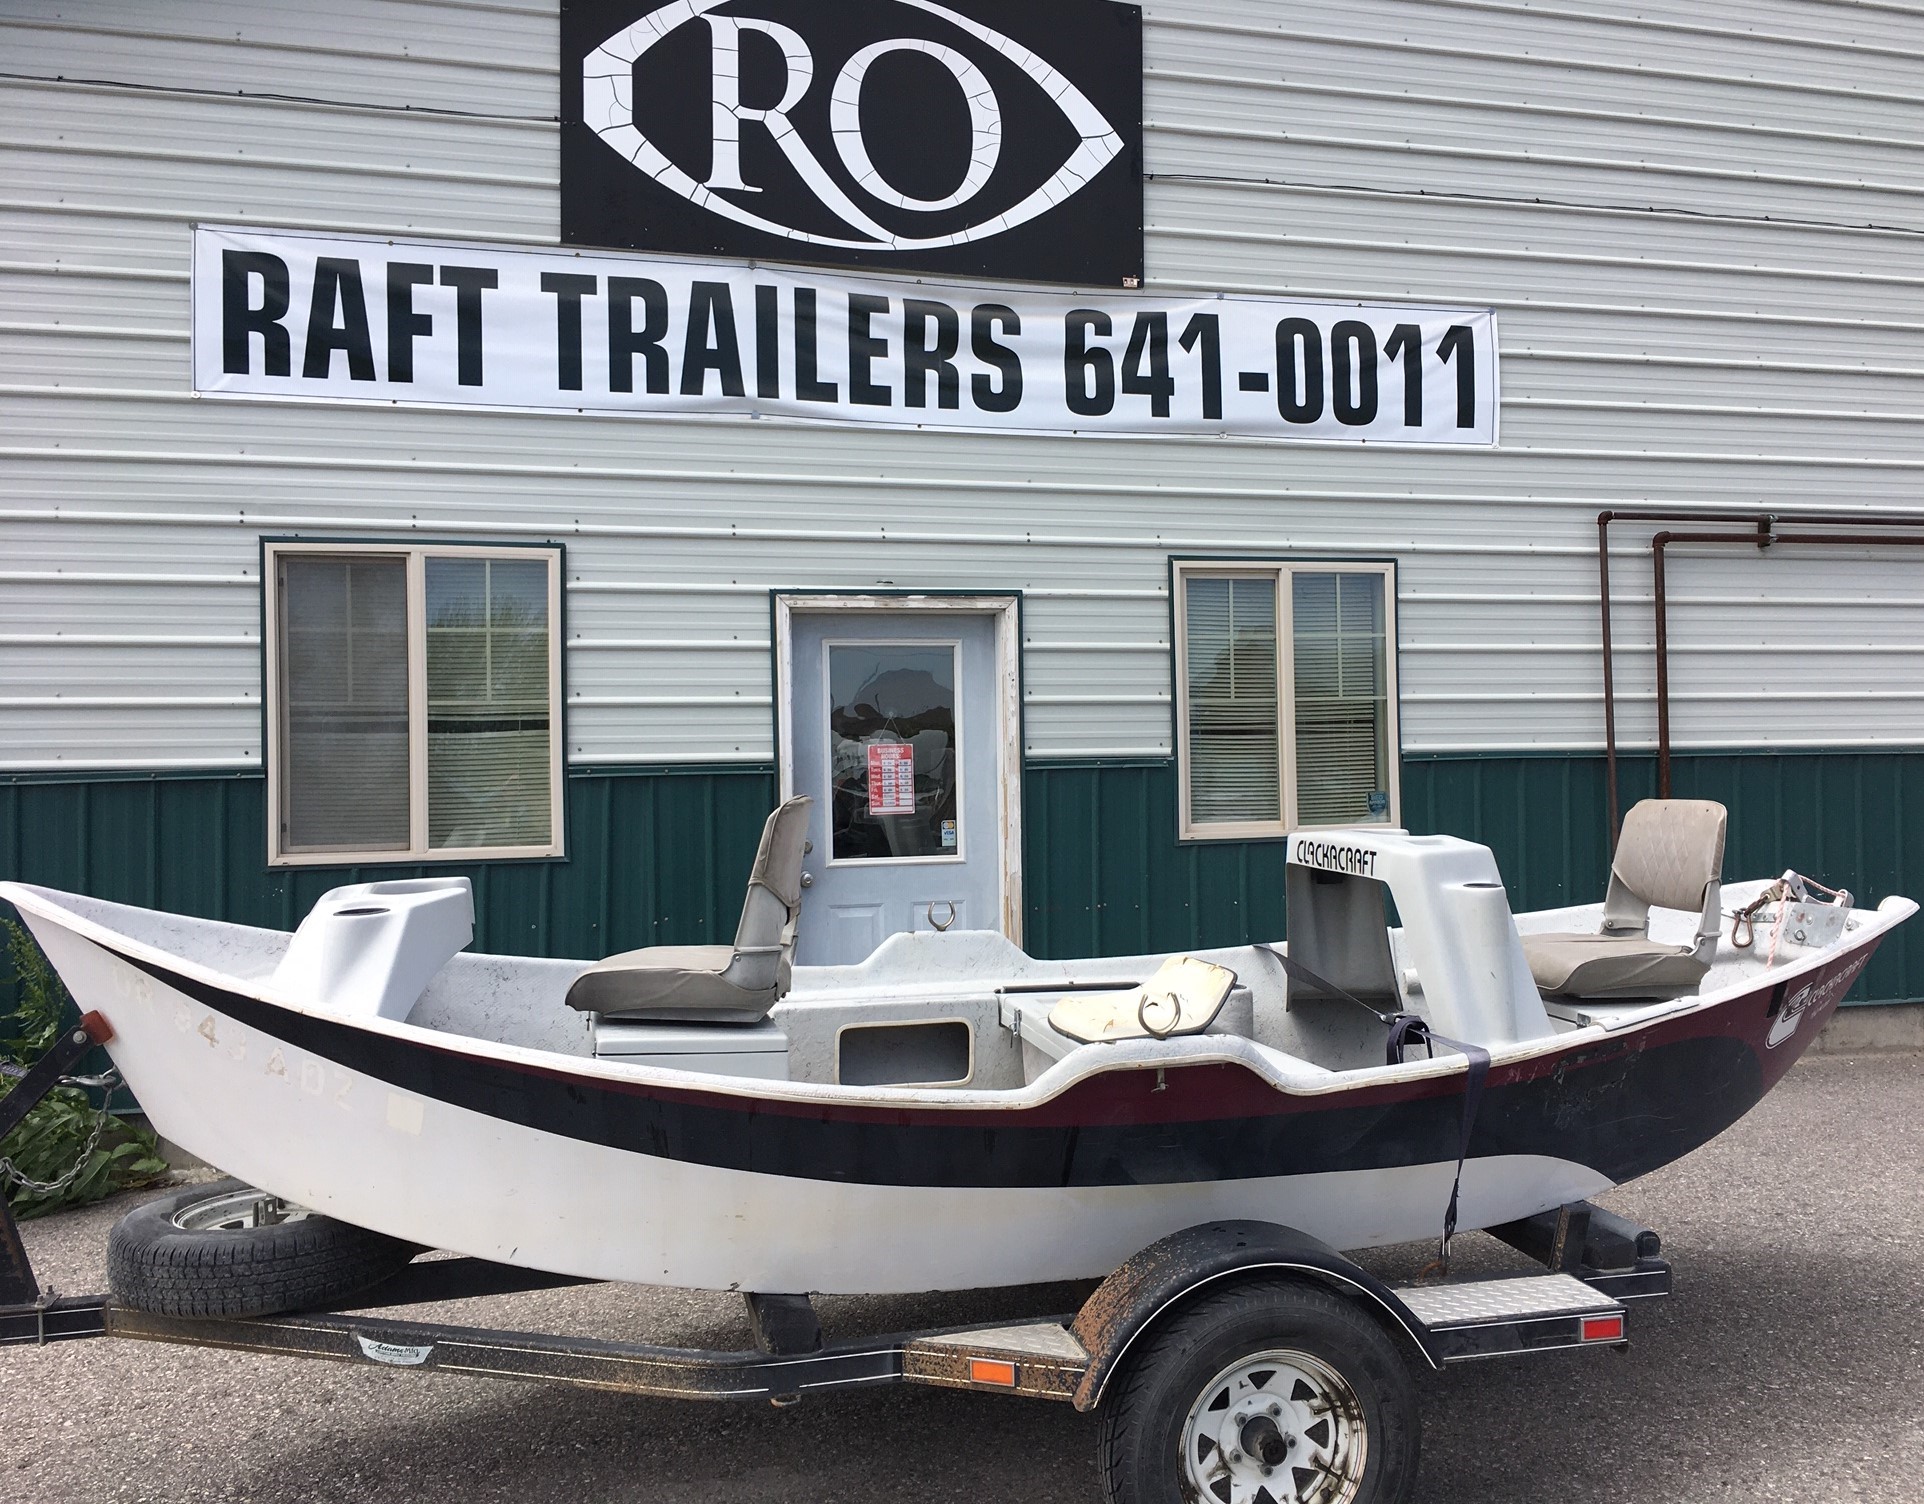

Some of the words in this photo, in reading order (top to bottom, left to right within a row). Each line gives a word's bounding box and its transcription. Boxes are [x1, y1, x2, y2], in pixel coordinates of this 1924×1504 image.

[222, 248, 499, 387] RAFT
[540, 271, 1024, 413] TRAILERS
[1063, 308, 1476, 429] 641-0011
[1296, 840, 1377, 877] CLACKACRAFT
